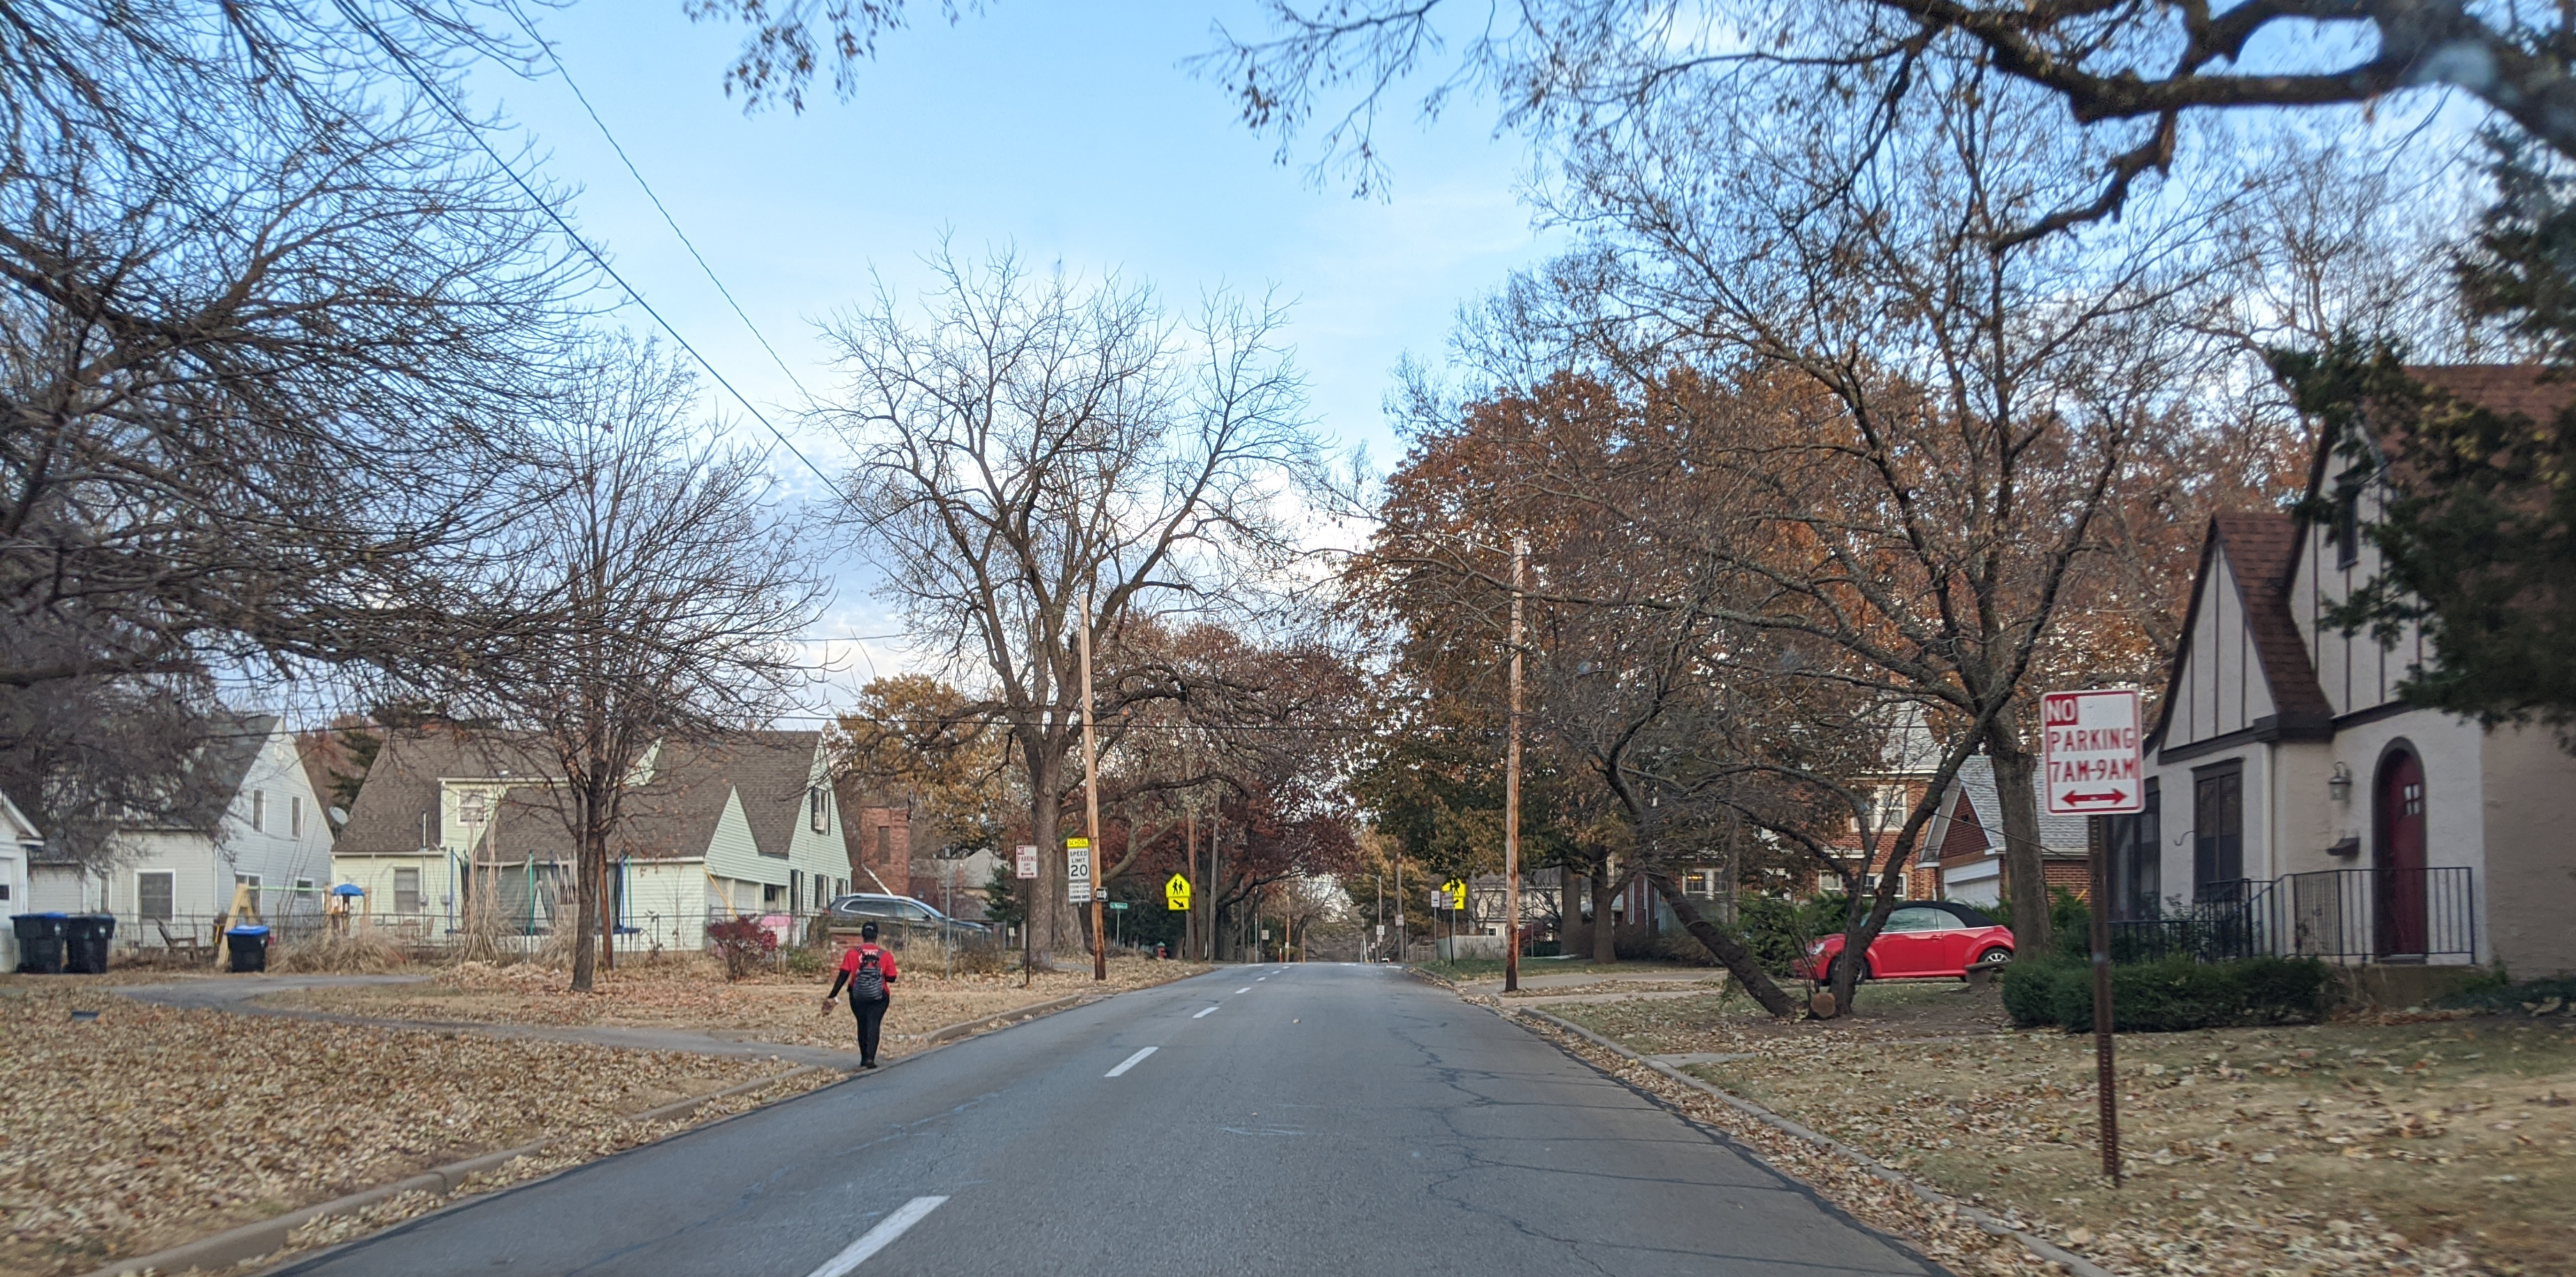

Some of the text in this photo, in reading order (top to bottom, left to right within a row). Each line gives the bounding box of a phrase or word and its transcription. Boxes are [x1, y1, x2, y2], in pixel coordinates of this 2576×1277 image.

[2046, 699, 2076, 722] NO
[2049, 728, 2136, 752] PARKING
[2048, 758, 2135, 783] 7AM-9AM
[1071, 864, 1087, 877] 20
